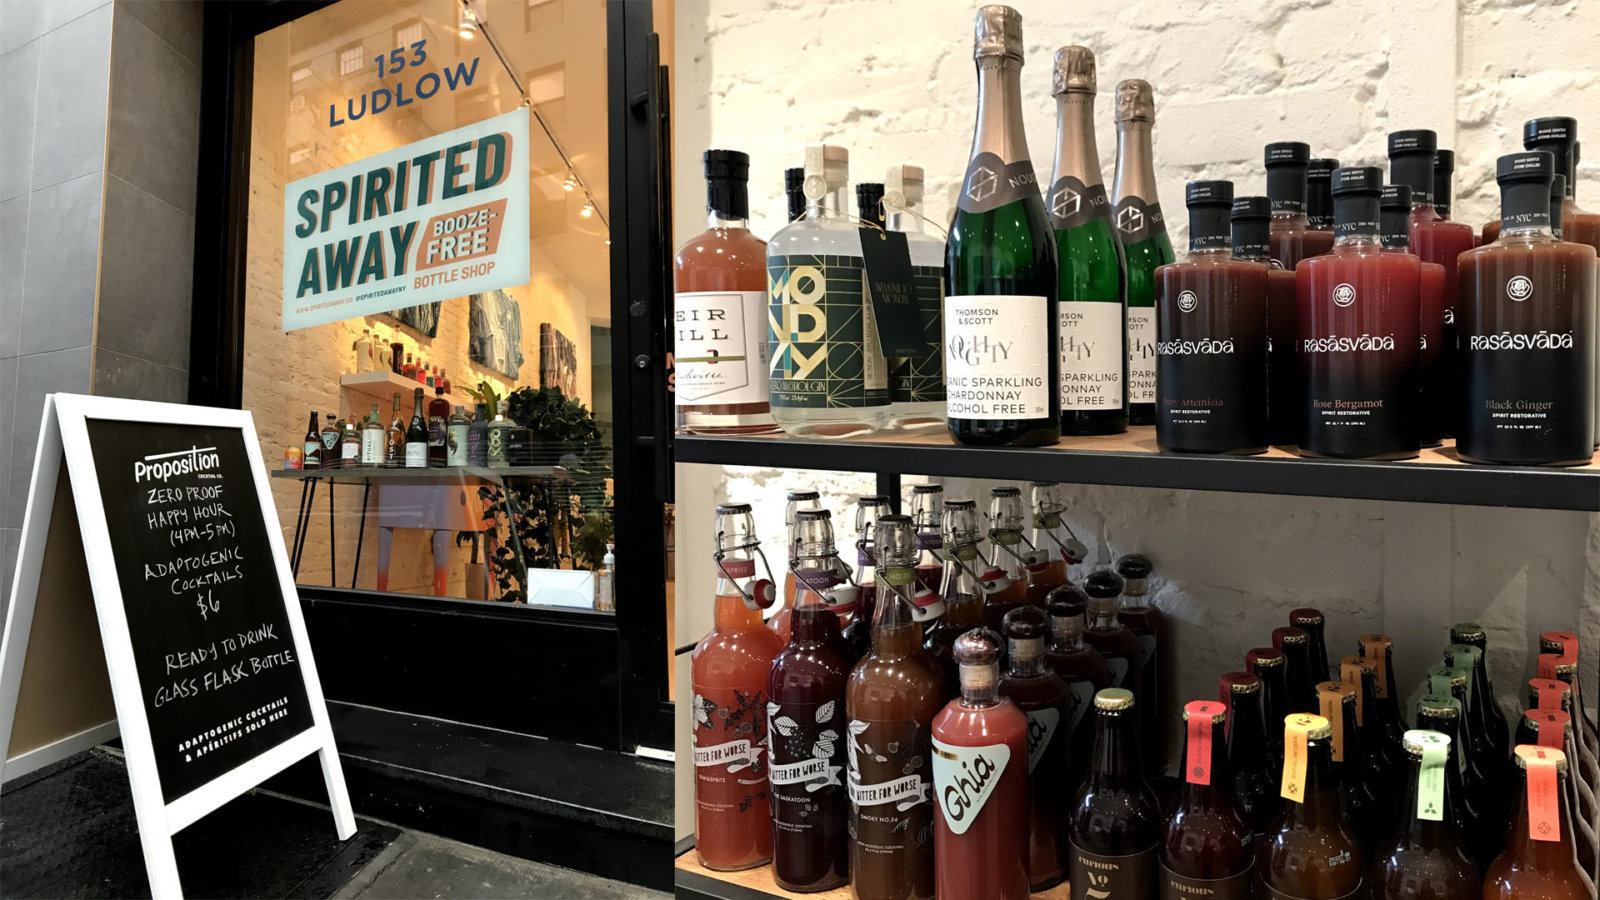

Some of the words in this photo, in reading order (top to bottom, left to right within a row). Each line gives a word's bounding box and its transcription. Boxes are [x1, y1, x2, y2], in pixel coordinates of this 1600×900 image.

[375, 39, 427, 79] 153
[329, 57, 480, 128] LUDLOW
[295, 131, 514, 238] SPIRITED
[433, 208, 498, 238] BOOZE-
[1341, 222, 1356, 231] NYC
[1515, 214, 1532, 223] NYC
[296, 221, 421, 299] AWAY
[426, 229, 489, 264] FREE
[414, 268, 458, 290] BOTTLE
[461, 261, 496, 280] SHOP
[955, 308, 999, 316] THOMSON
[971, 377, 1042, 388] SPARKLING
[993, 404, 1026, 414] FREE
[1077, 396, 1105, 405] FREE
[1313, 399, 1332, 408] Rose
[1335, 399, 1383, 410] Bergamot
[1485, 399, 1513, 410] Black
[1515, 399, 1554, 411] Ginger
[134, 445, 220, 483] Proposition
[148, 487, 183, 504] ZERO
[186, 485, 223, 502] PROOF
[148, 508, 188, 530] HAPPY
[193, 503, 232, 520] HOUR
[145, 546, 244, 581] ADAPTOGENIC
[171, 565, 243, 595] COCKTAILS
[196, 589, 220, 621] $6
[165, 642, 218, 675] READY
[221, 638, 236, 655] TO
[237, 623, 278, 649] DRINK
[155, 678, 198, 708] GLASS
[204, 661, 249, 691] FLASK
[249, 650, 295, 675] BOTTLE
[179, 717, 243, 752] ADAPTOGENIC
[246, 697, 288, 721] COCKTAILS
[185, 754, 192, 763] &
[245, 719, 266, 734] SOLD
[269, 708, 288, 722] HERE
[711, 749, 722, 760] FOR
[724, 743, 747, 757] WORSE
[789, 768, 801, 779] FOR
[802, 762, 825, 776] WORSE
[780, 795, 811, 803] SASKATOON
[879, 787, 891, 799] FOR
[894, 779, 917, 795] WORSE
[944, 754, 996, 821] Ghia
[860, 813, 878, 822] SMOKY
